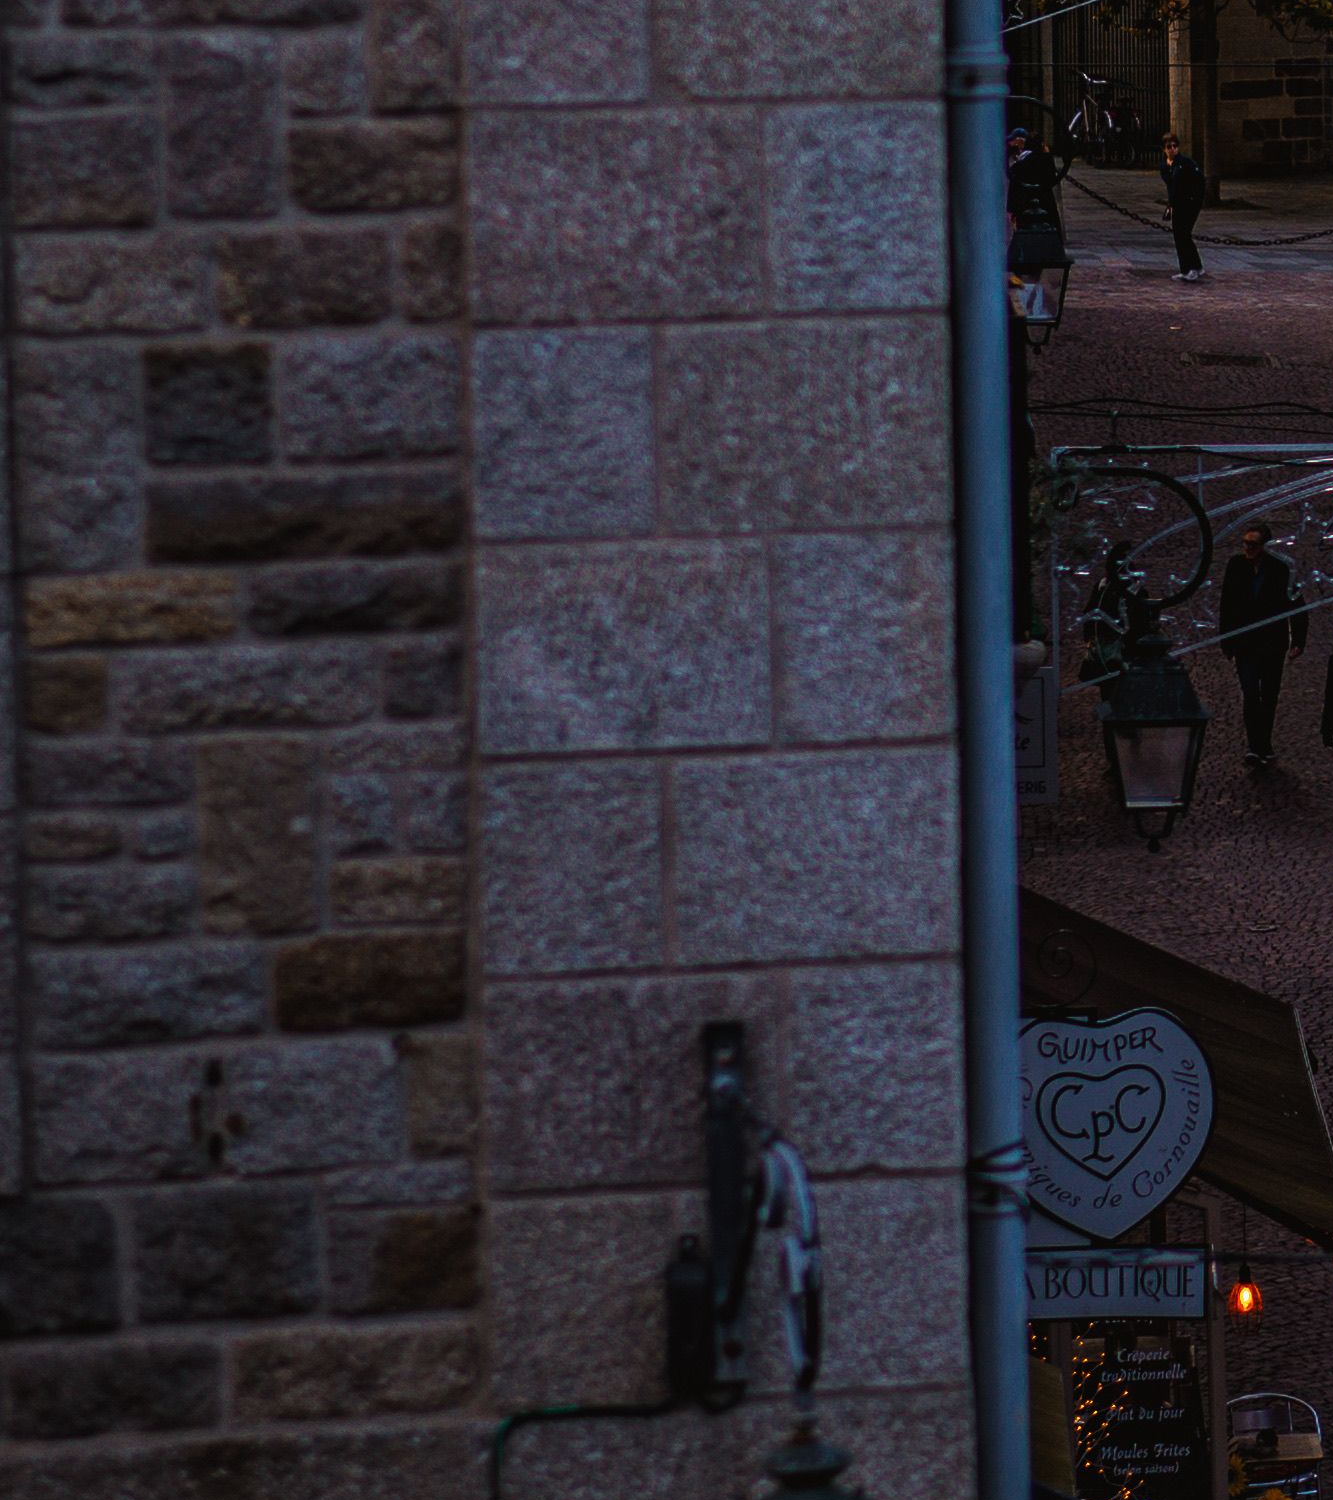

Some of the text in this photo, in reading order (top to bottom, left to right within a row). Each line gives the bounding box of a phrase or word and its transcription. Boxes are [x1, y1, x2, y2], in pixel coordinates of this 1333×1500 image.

[1093, 1184, 1122, 1209] de
[1132, 1058, 1200, 1198] Cornouaille
[1044, 1265, 1195, 1302] BOUTIQUE
[1101, 1363, 1187, 1382] traditionnelle
[1138, 1405, 1154, 1421] du
[1158, 1404, 1185, 1423] jour
[1101, 1442, 1192, 1461] Moules Frites
